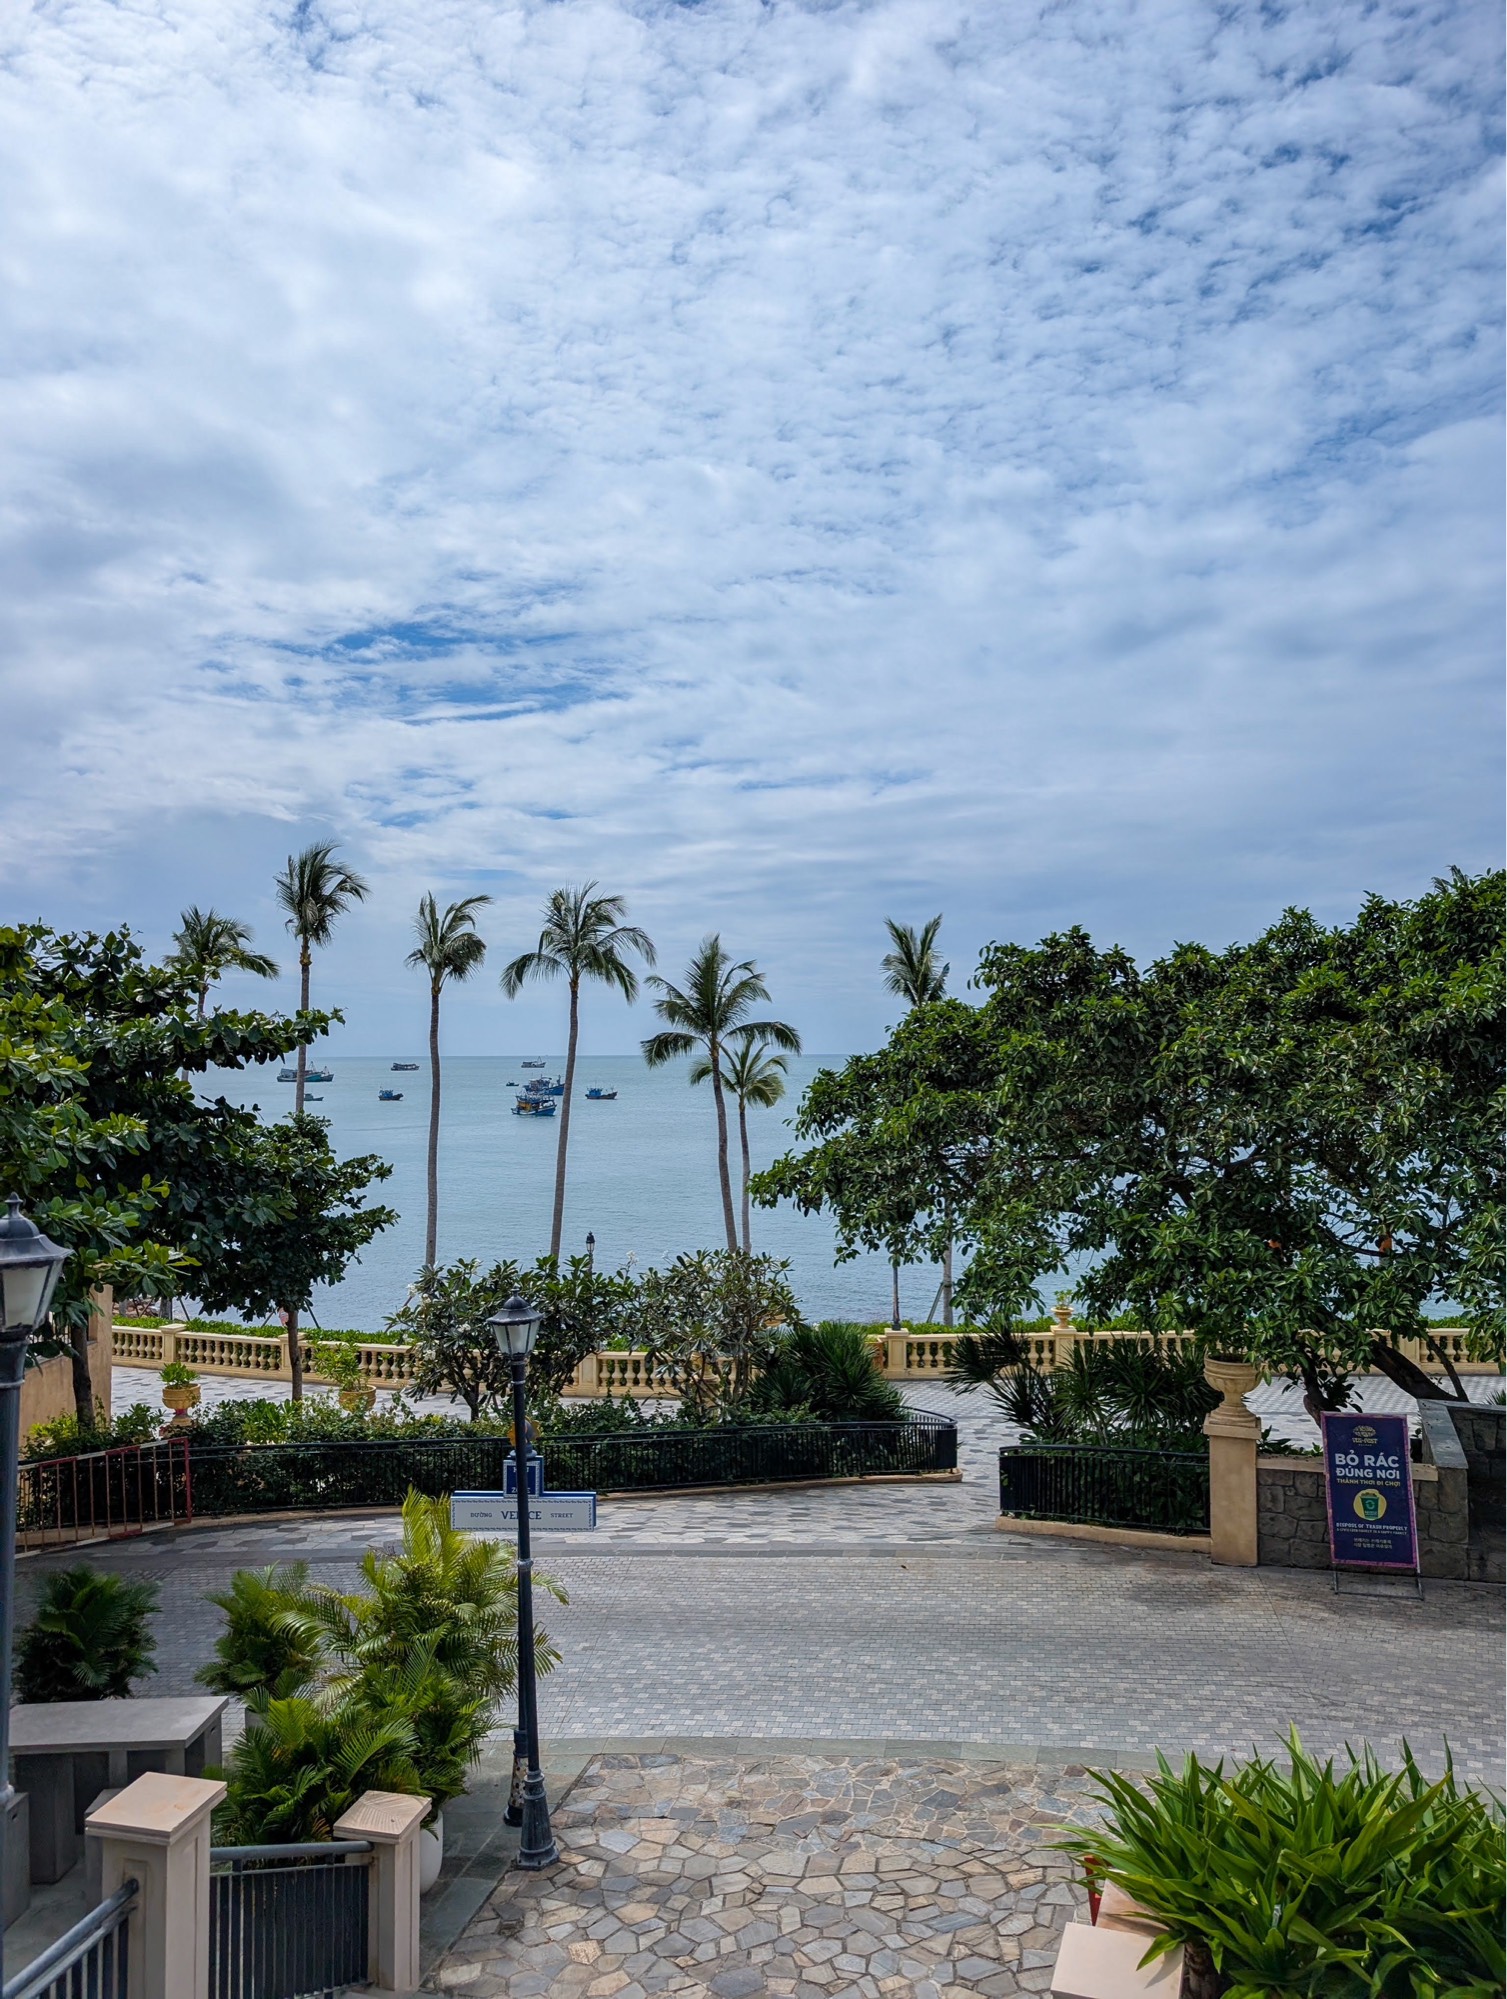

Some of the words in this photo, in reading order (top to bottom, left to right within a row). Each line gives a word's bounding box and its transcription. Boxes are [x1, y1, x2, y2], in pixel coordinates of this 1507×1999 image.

[1335, 1450, 1359, 1466] BỎ
[1364, 1452, 1400, 1468] RÁC
[1336, 1466, 1373, 1478] ĐÚNG
[1376, 1469, 1400, 1479] NƠI
[500, 1511, 542, 1520] VECE
